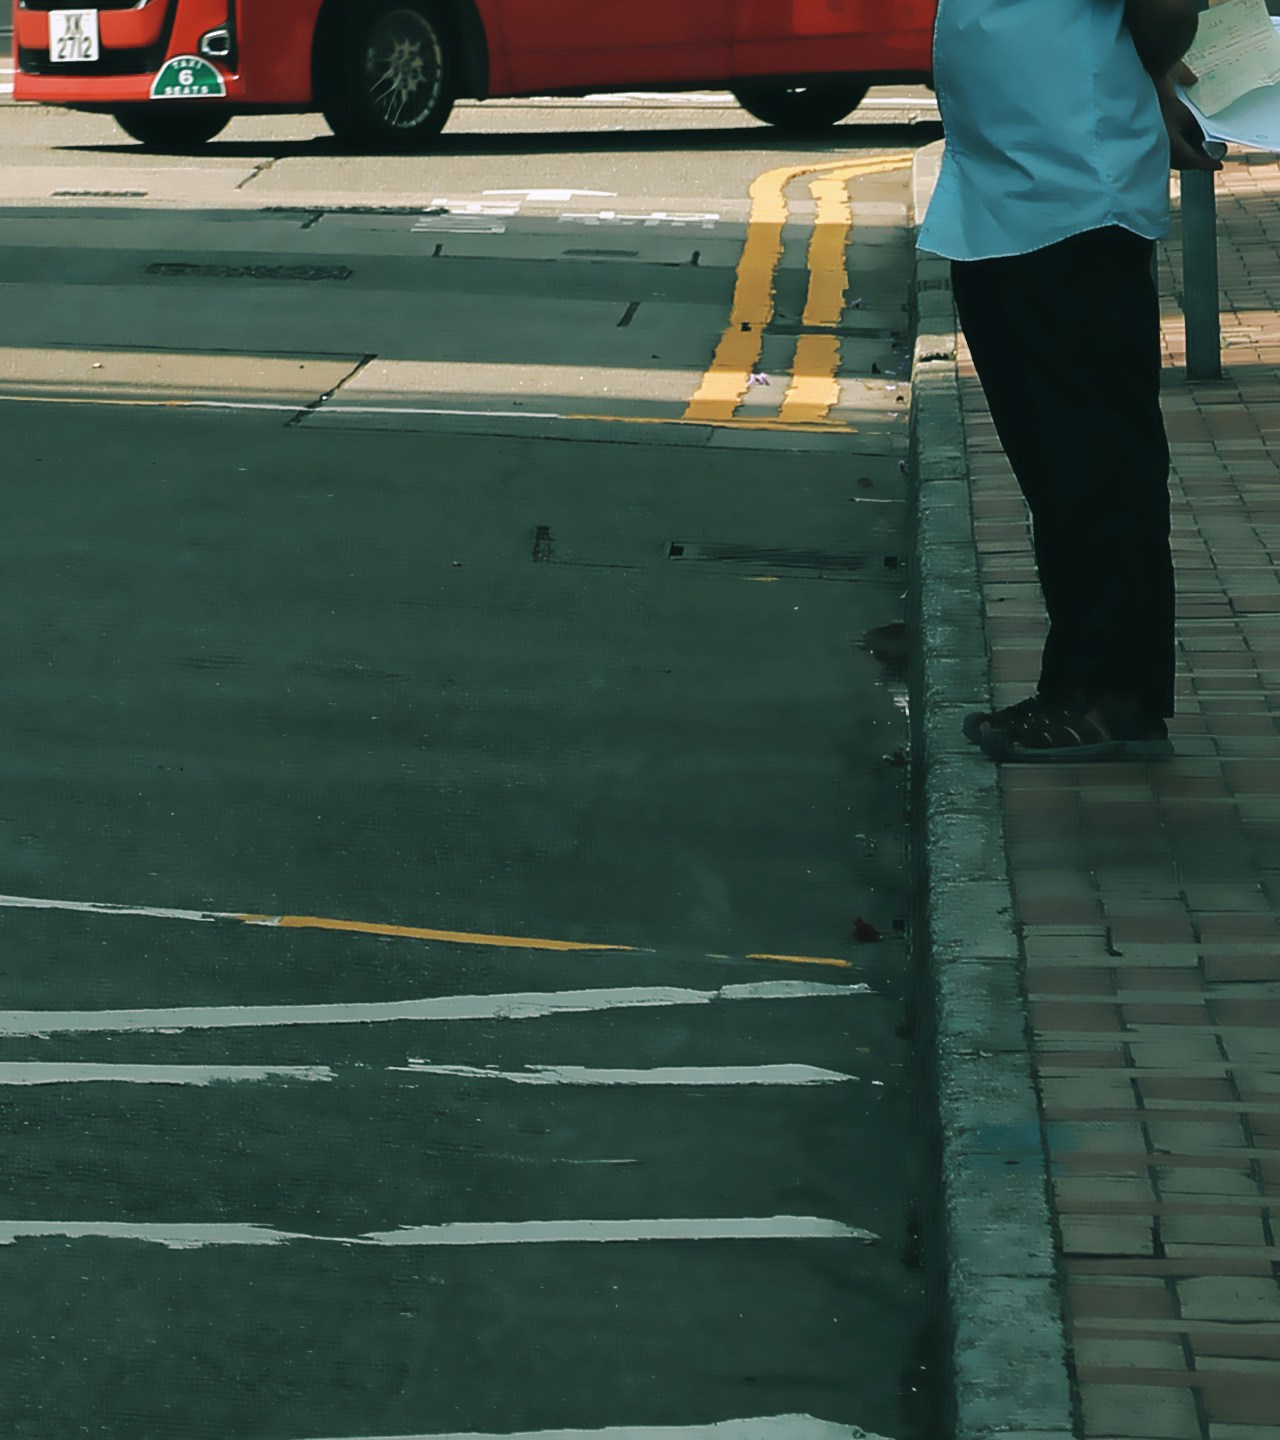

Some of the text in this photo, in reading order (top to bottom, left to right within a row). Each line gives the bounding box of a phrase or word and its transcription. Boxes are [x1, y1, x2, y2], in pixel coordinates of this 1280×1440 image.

[171, 57, 204, 71] TAXI
[178, 69, 194, 85] 6
[164, 85, 209, 96] SEATS
